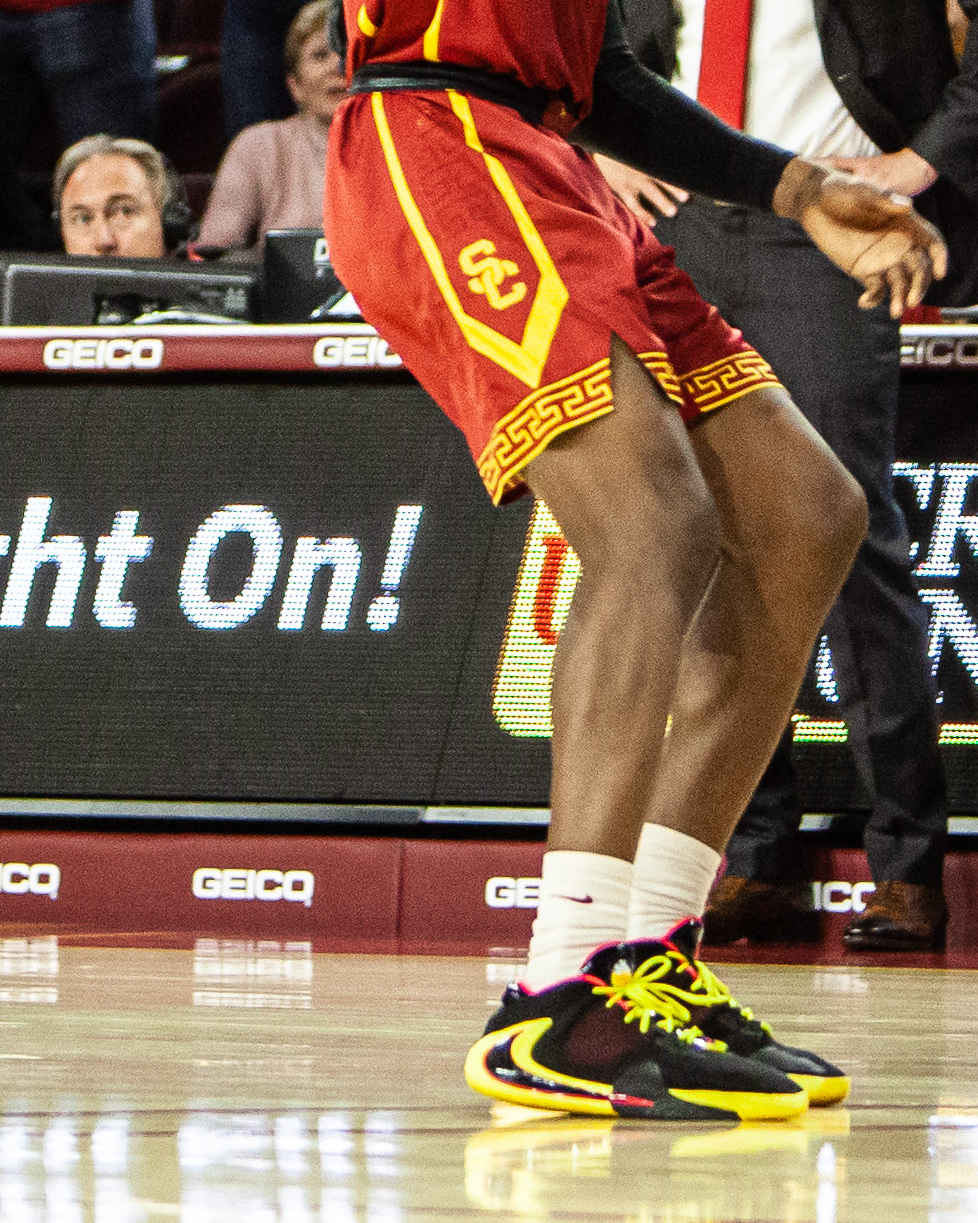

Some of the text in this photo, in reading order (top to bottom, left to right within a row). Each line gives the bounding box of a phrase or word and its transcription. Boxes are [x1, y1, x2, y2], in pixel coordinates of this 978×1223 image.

[43, 339, 164, 369] GEICO
[0, 496, 154, 628] ht
[178, 504, 424, 631] On!
[192, 867, 315, 902] GEICO
